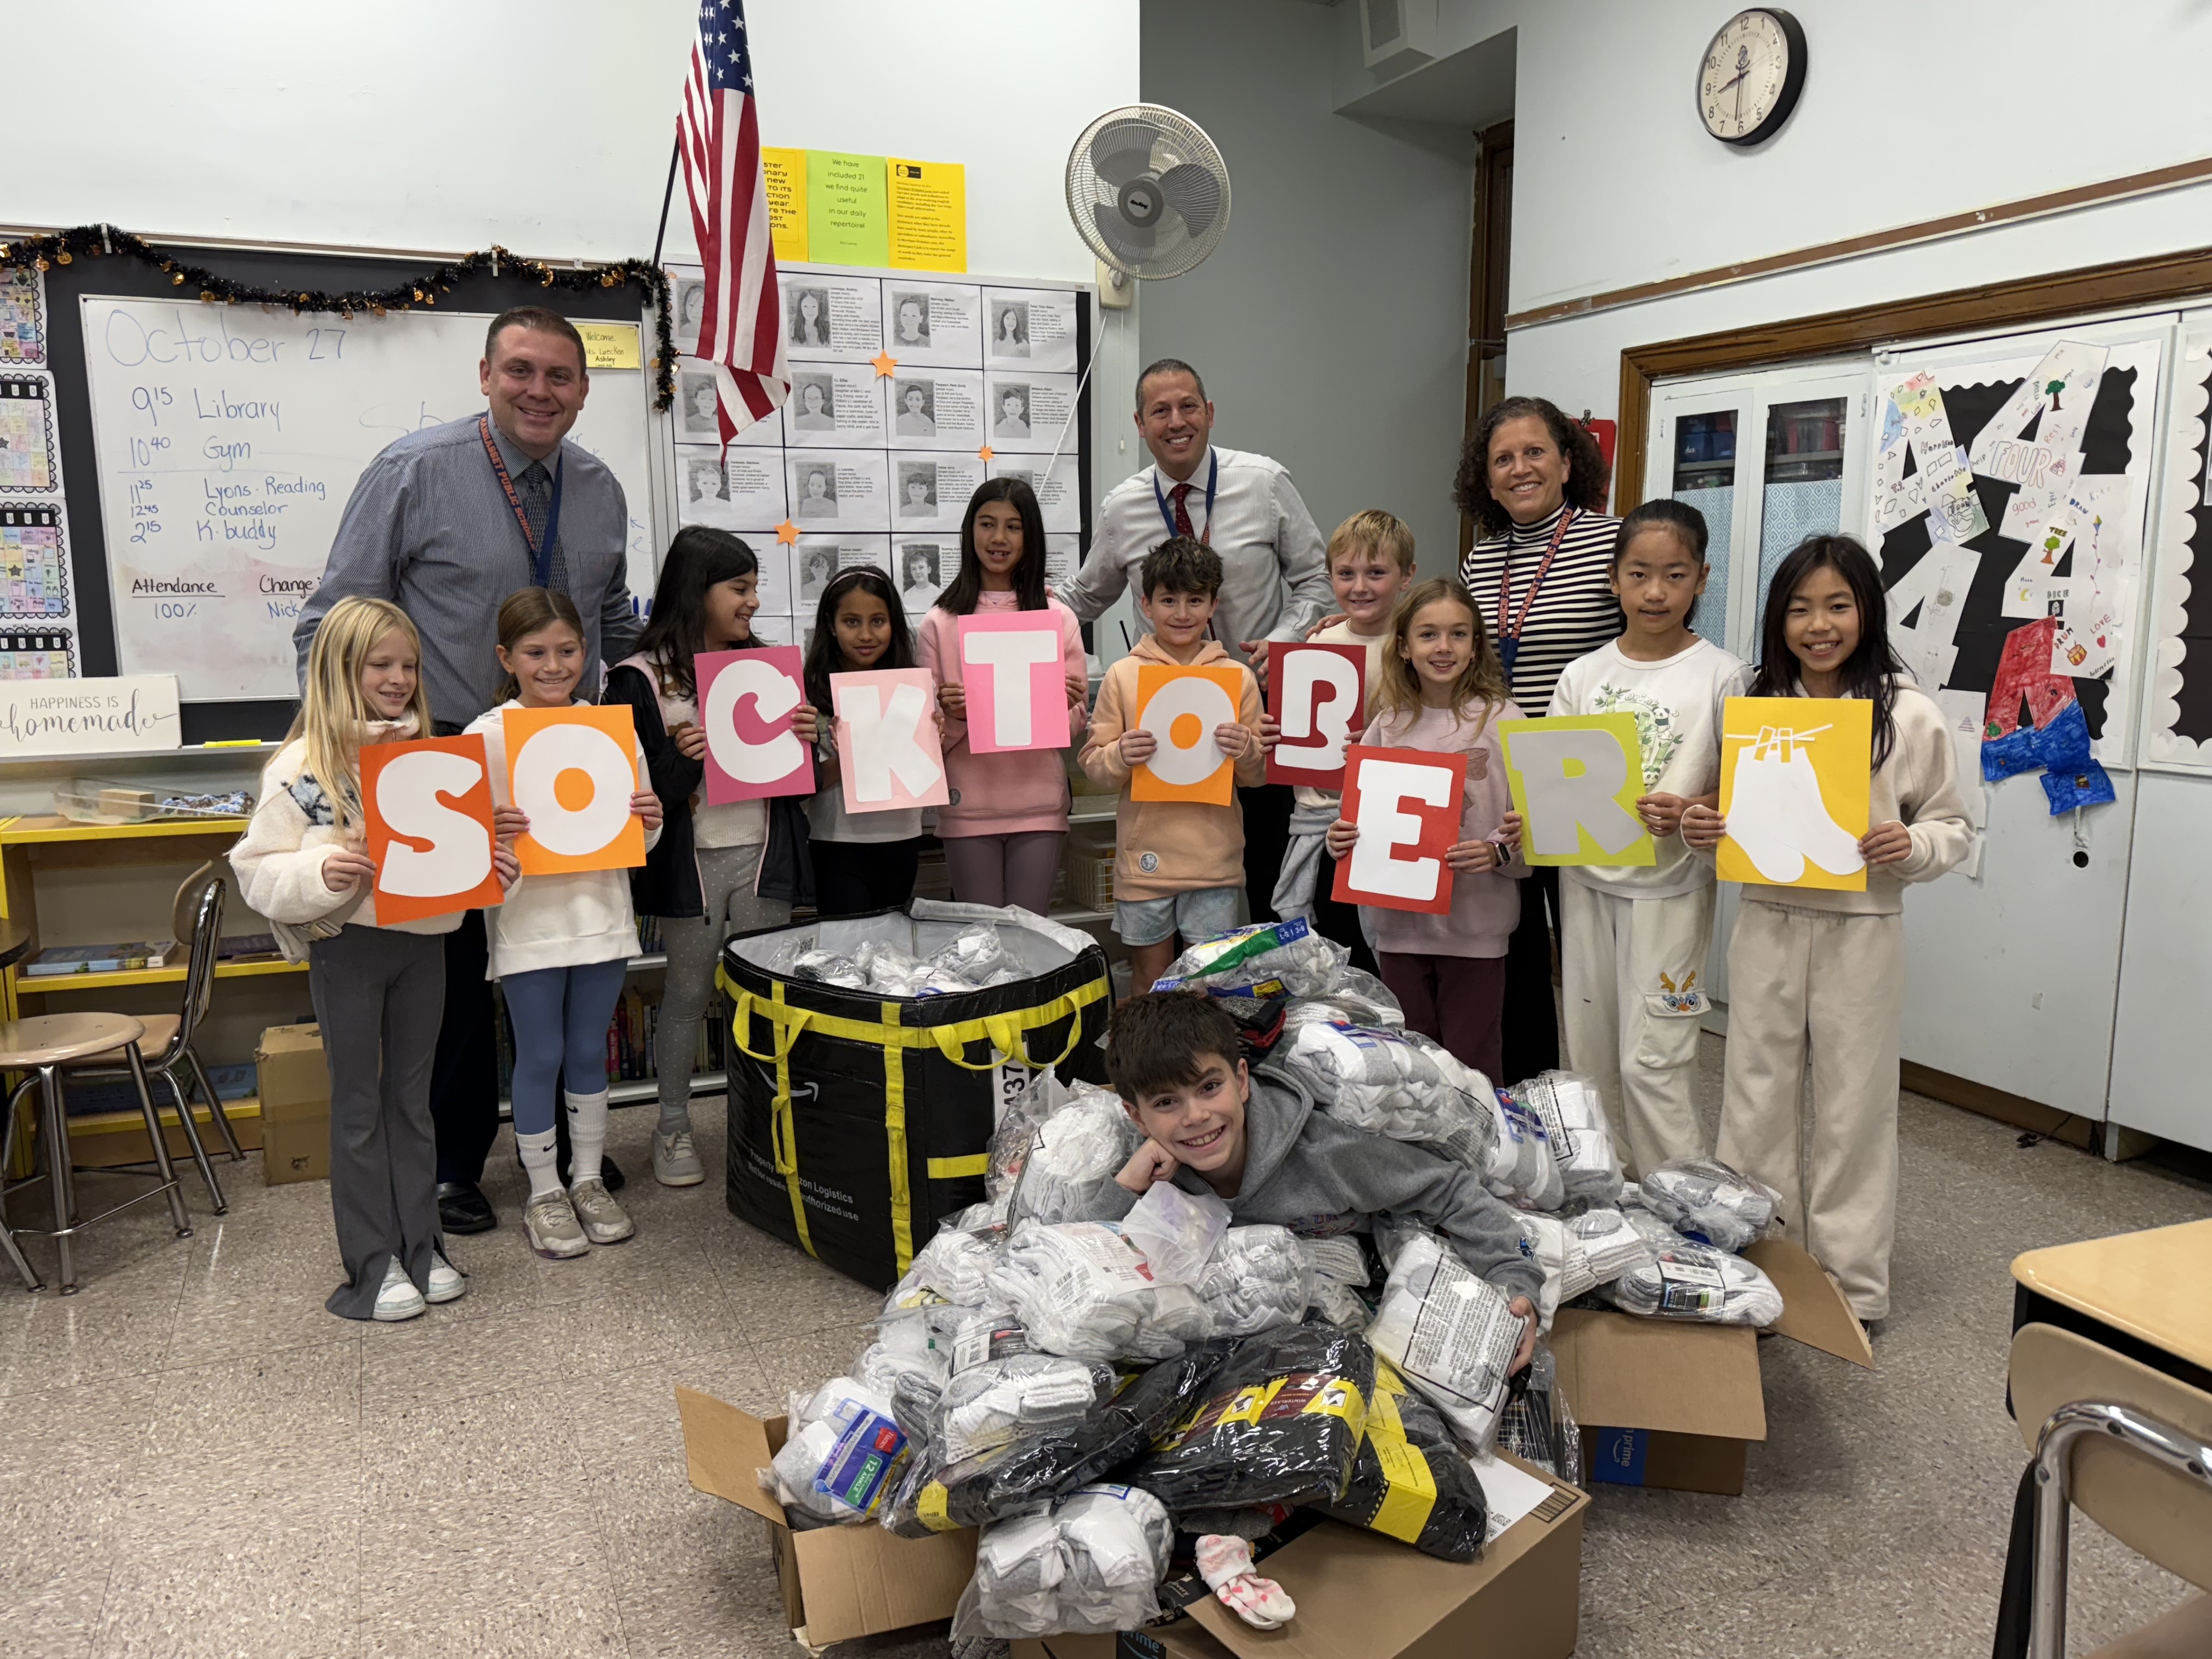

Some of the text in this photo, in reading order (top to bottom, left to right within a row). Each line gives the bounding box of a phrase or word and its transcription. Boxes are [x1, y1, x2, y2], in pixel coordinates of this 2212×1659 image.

[1740, 16, 1750, 31] 12
[1761, 18, 1765, 30] 1
[1720, 32, 1729, 46] 11
[1707, 57, 1717, 70] 10
[1775, 55, 1783, 70] 3
[1705, 83, 1712, 96] 9
[1769, 83, 1776, 96] 4
[1708, 106, 1714, 119] 8
[1756, 108, 1763, 121] 5
[1719, 120, 1725, 134] 7
[1738, 121, 1744, 133] 6
[828, 171, 856, 180] included
[831, 221, 865, 229] repertoire!
[106, 309, 346, 366] October 27
[585, 331, 616, 341] Welcome
[595, 356, 615, 365] Ashley
[194, 388, 281, 432] Library
[2044, 423, 2062, 443] Rest
[203, 436, 251, 472] Gym
[1972, 454, 1986, 466] help
[1990, 441, 2052, 489] FOUR
[266, 476, 326, 501] Reading
[498, 471, 519, 506] PUBLIC
[206, 502, 288, 516] Counselor
[2012, 498, 2036, 516] good
[2048, 491, 2057, 508] Epic
[2069, 498, 2089, 514] DRAW
[225, 519, 276, 549] buddy
[2050, 527, 2067, 537] TREE
[1511, 507, 1573, 639] MANHASSET PUBLIC SCHOOLS
[132, 574, 314, 599] Attendance Change
[2047, 590, 2069, 599] DICE
[155, 603, 197, 619] 100%
[1499, 597, 1508, 637] SCHOOLS
[2090, 614, 2112, 634] LOVE
[2054, 627, 2073, 650] DRUM
[964, 630, 1057, 746] T
[30, 696, 119, 709] HAPPINESS IS
[1624, 691, 1659, 707] Drink
[0, 688, 177, 742] homemade
[1275, 649, 1359, 770] B
[706, 659, 804, 783] C
[1138, 676, 1235, 785] O
[838, 682, 941, 802] K
[513, 723, 635, 855] O
[1507, 729, 1646, 855] R
[376, 751, 492, 897] S
[1347, 758, 1453, 901] E
[766, 1176, 786, 1192] resale
[843, 1210, 859, 1221] use
[814, 1182, 853, 1204] Logistics
[879, 1432, 894, 1448] Hanes
[1621, 1434, 1634, 1467] prime
[853, 1460, 877, 1492] 12 ANKLE
